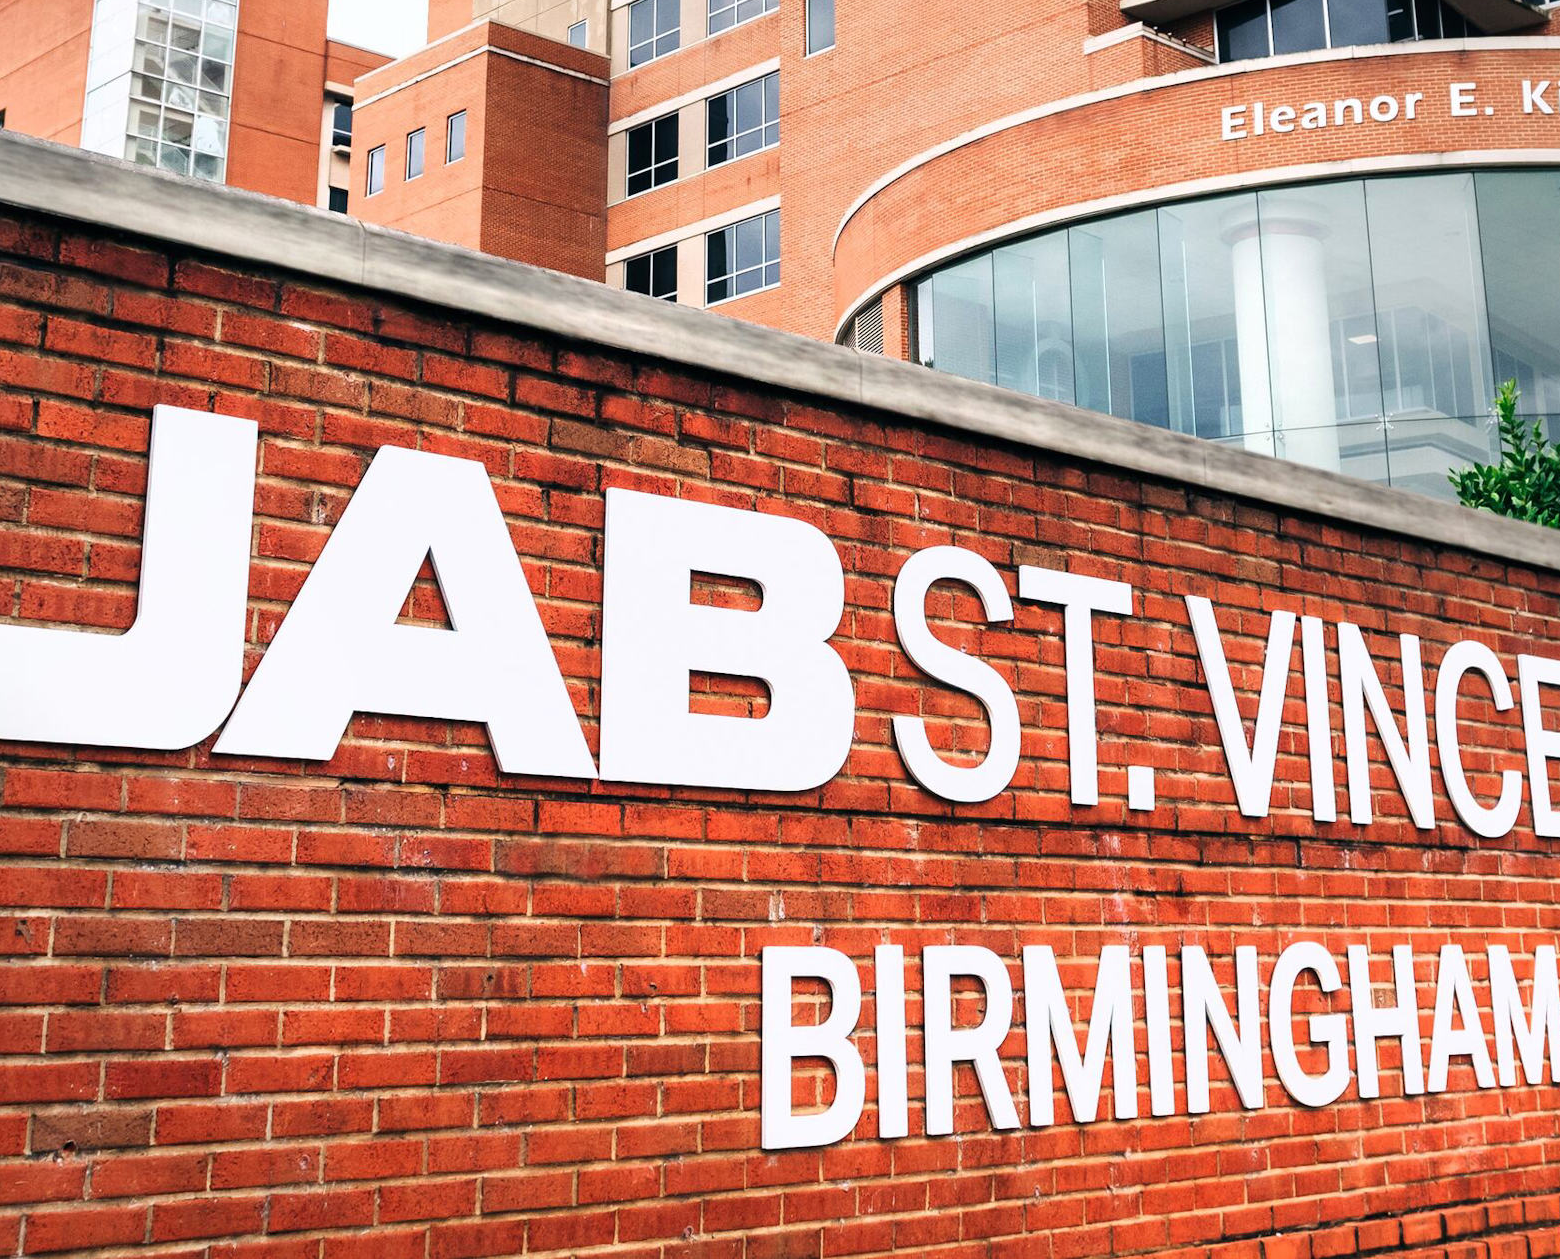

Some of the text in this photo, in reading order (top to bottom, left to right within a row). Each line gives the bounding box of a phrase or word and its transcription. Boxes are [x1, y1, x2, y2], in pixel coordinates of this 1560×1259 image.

[1221, 92, 1423, 141] Eleanor
[1449, 82, 1494, 117] E.
[893, 544, 1156, 812] ST.
